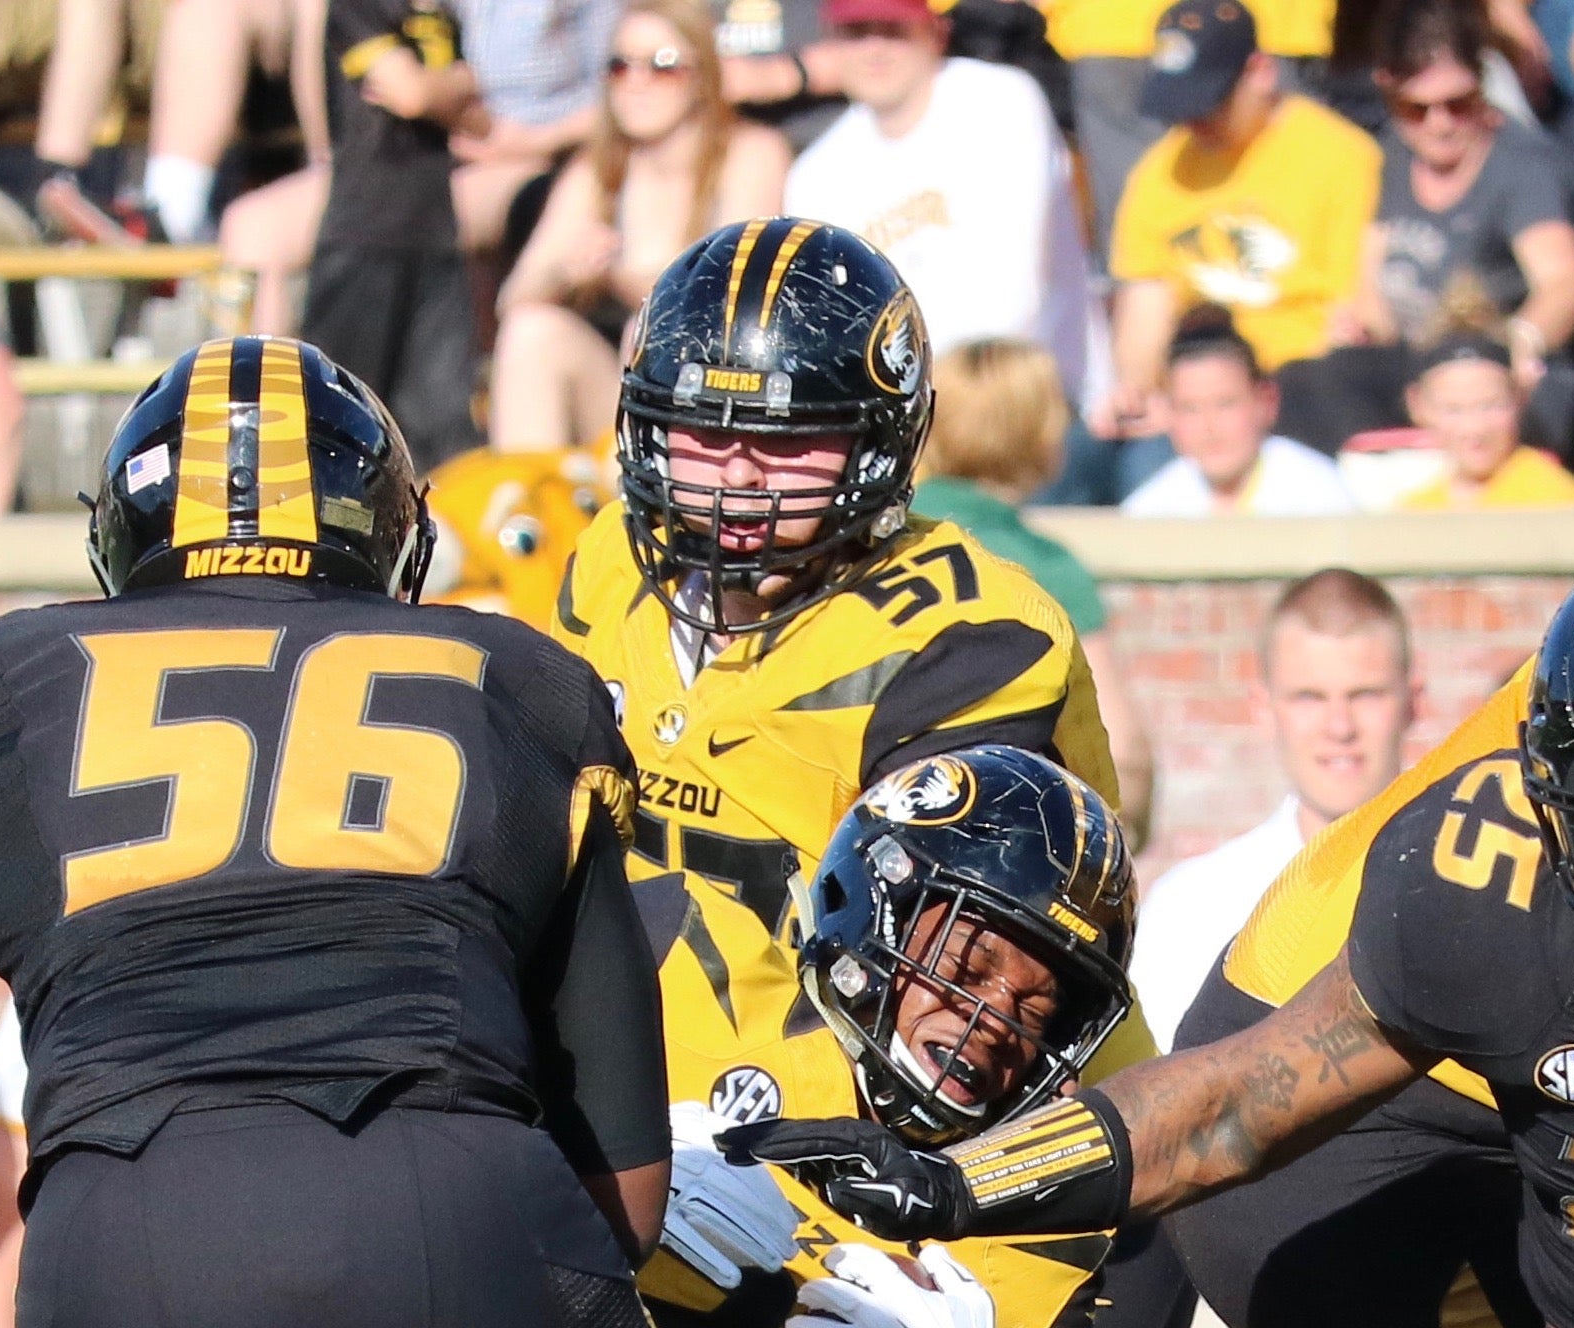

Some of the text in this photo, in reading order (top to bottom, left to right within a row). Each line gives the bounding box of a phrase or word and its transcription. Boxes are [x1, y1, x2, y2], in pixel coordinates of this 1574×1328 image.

[705, 369, 761, 392] TIGERS
[184, 548, 312, 579] MIZZOU
[855, 543, 982, 628] 57
[55, 625, 492, 928] 56
[1432, 758, 1543, 913] 25
[1047, 901, 1100, 943] TIGERS
[711, 1067, 779, 1125] SEC
